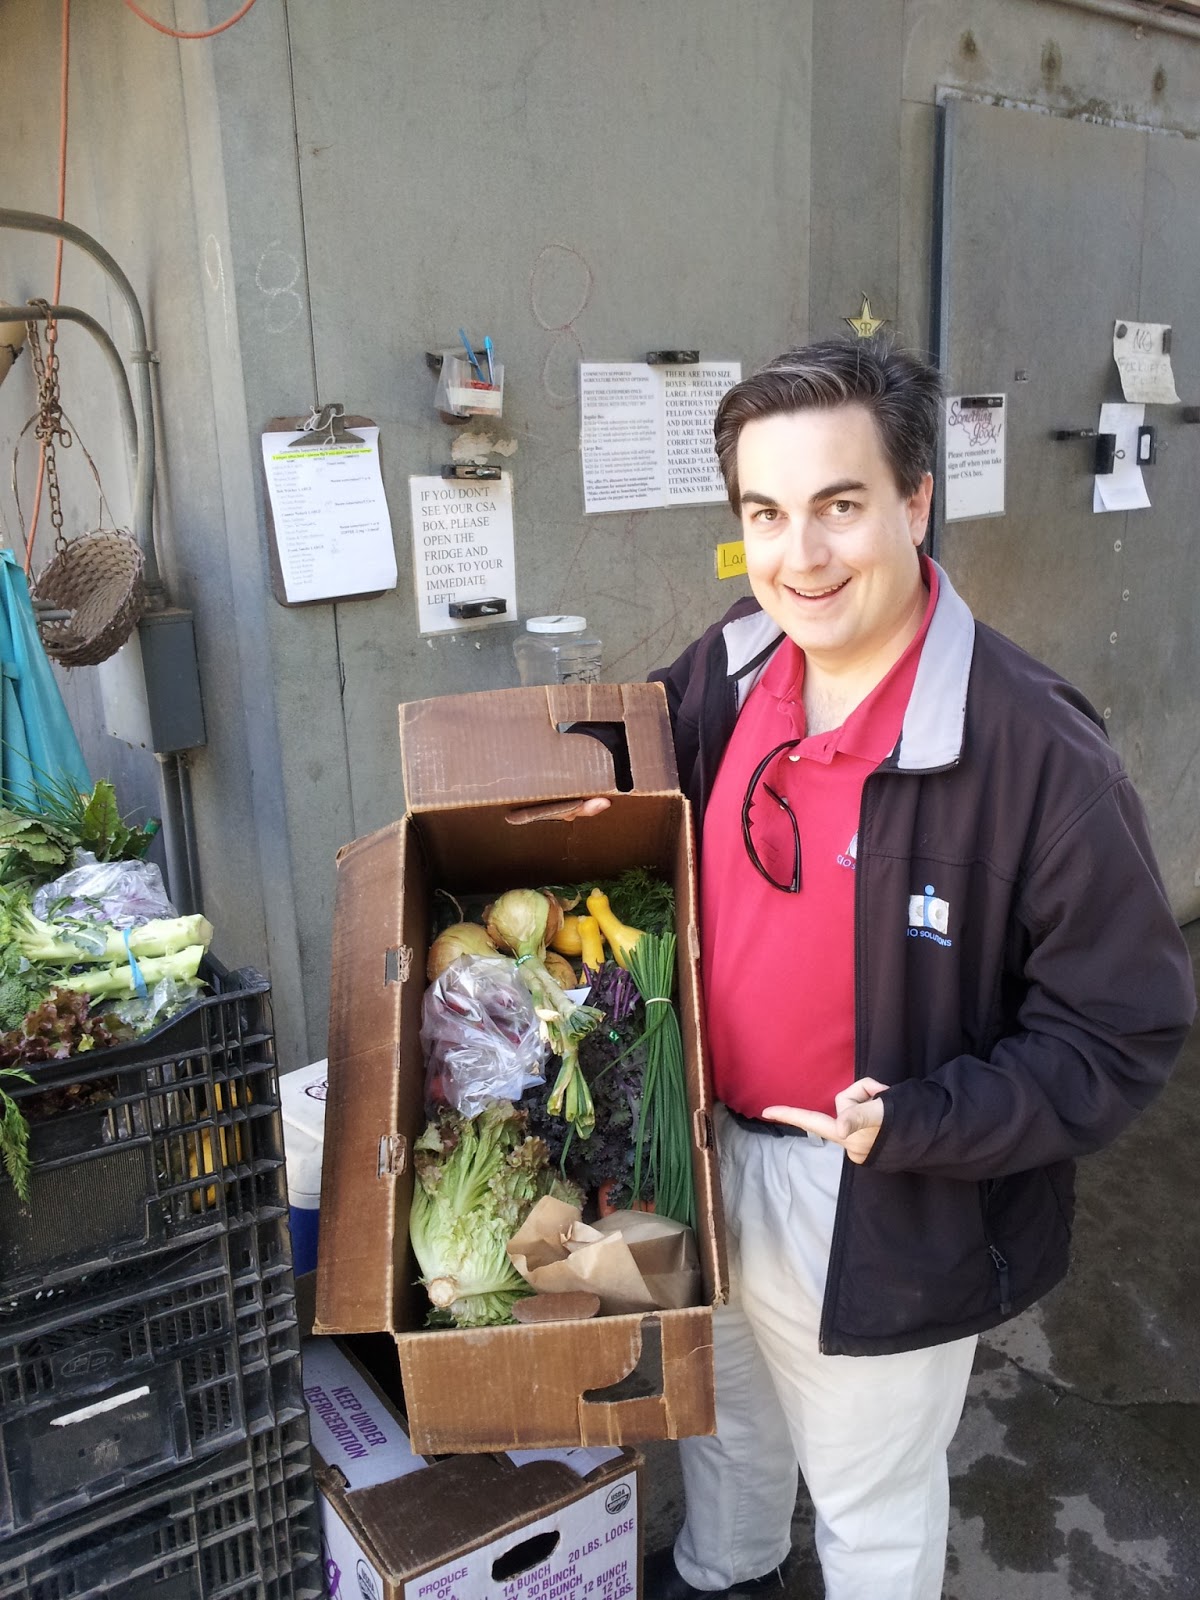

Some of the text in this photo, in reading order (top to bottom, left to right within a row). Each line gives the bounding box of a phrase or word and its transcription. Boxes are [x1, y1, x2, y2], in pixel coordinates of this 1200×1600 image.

[1133, 328, 1152, 352] NO
[665, 370, 732, 378] THERE ARE TWO SIZE
[665, 380, 687, 388] BOXES
[692, 380, 723, 388] REGULAR
[724, 380, 737, 388] AND
[690, 390, 714, 398] PLEASE
[665, 400, 703, 408] COURTIOUS
[694, 409, 708, 417] CSA
[948, 400, 993, 429] Something
[681, 419, 708, 427] DOUBLE
[667, 429, 680, 437] YOU
[666, 438, 698, 447] CORRECT
[667, 447, 713, 456] LARGE SHARE
[948, 451, 964, 460] Please
[964, 449, 990, 458] remember
[667, 457, 697, 466] MARKED
[948, 457, 1003, 470] sign off when you take
[667, 467, 701, 475] CONTAINS
[701, 466, 706, 474] 5
[948, 473, 960, 481] your
[960, 471, 973, 479] CSA
[668, 477, 689, 485] ITEMS
[420, 486, 490, 502] IF YOU DON'T
[669, 486, 696, 495] THANKS
[696, 485, 714, 493] VERY
[421, 501, 497, 517] SEE YOUR CSA
[450, 516, 490, 530] PLEASE
[423, 532, 475, 547] OPEN THE
[424, 546, 488, 561] FRIDGE AND
[425, 558, 504, 576] LOOK TO YOUR
[426, 575, 486, 590] IMMEDIATE
[427, 592, 456, 606] LEFT!
[303, 1385, 369, 1460] REFRIGERATION
[331, 1386, 388, 1447] KEEP UNDER
[611, 1489, 625, 1501] USDA
[568, 1518, 634, 1564] 20 LBS. LOOSE
[418, 1566, 469, 1598] PRODUCE
[503, 1563, 551, 1598] 14 BUNCH
[527, 1583, 540, 1599] 30
[542, 1564, 576, 1591] BUNCH
[583, 1560, 627, 1595] 12 BUNCH
[603, 1572, 629, 1595] 12 CT.
[436, 1585, 452, 1600] OF
[549, 1573, 583, 1599] BUNCH
[614, 1582, 634, 1600] LBS.
